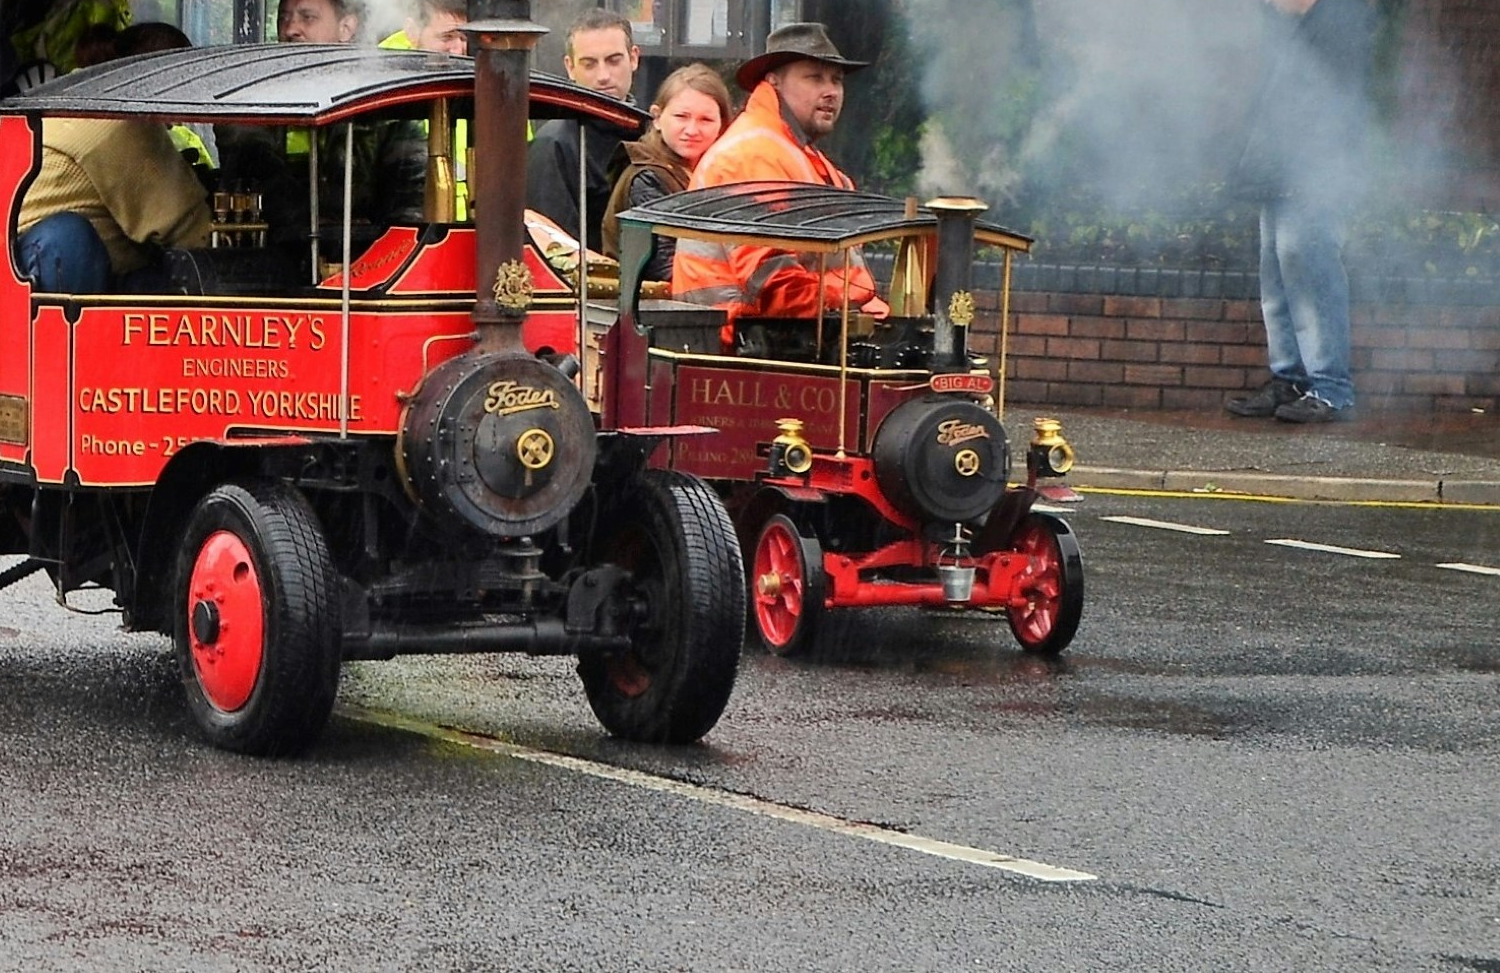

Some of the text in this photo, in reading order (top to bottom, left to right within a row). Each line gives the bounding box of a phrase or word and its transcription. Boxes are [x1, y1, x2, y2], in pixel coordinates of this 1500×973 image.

[122, 313, 327, 350] FEARNLEY'S
[182, 358, 290, 379] ENGINEERS
[940, 376, 984, 390] BIG AL
[484, 381, 560, 417] Foden
[691, 378, 767, 408] HALL
[774, 383, 792, 409] &
